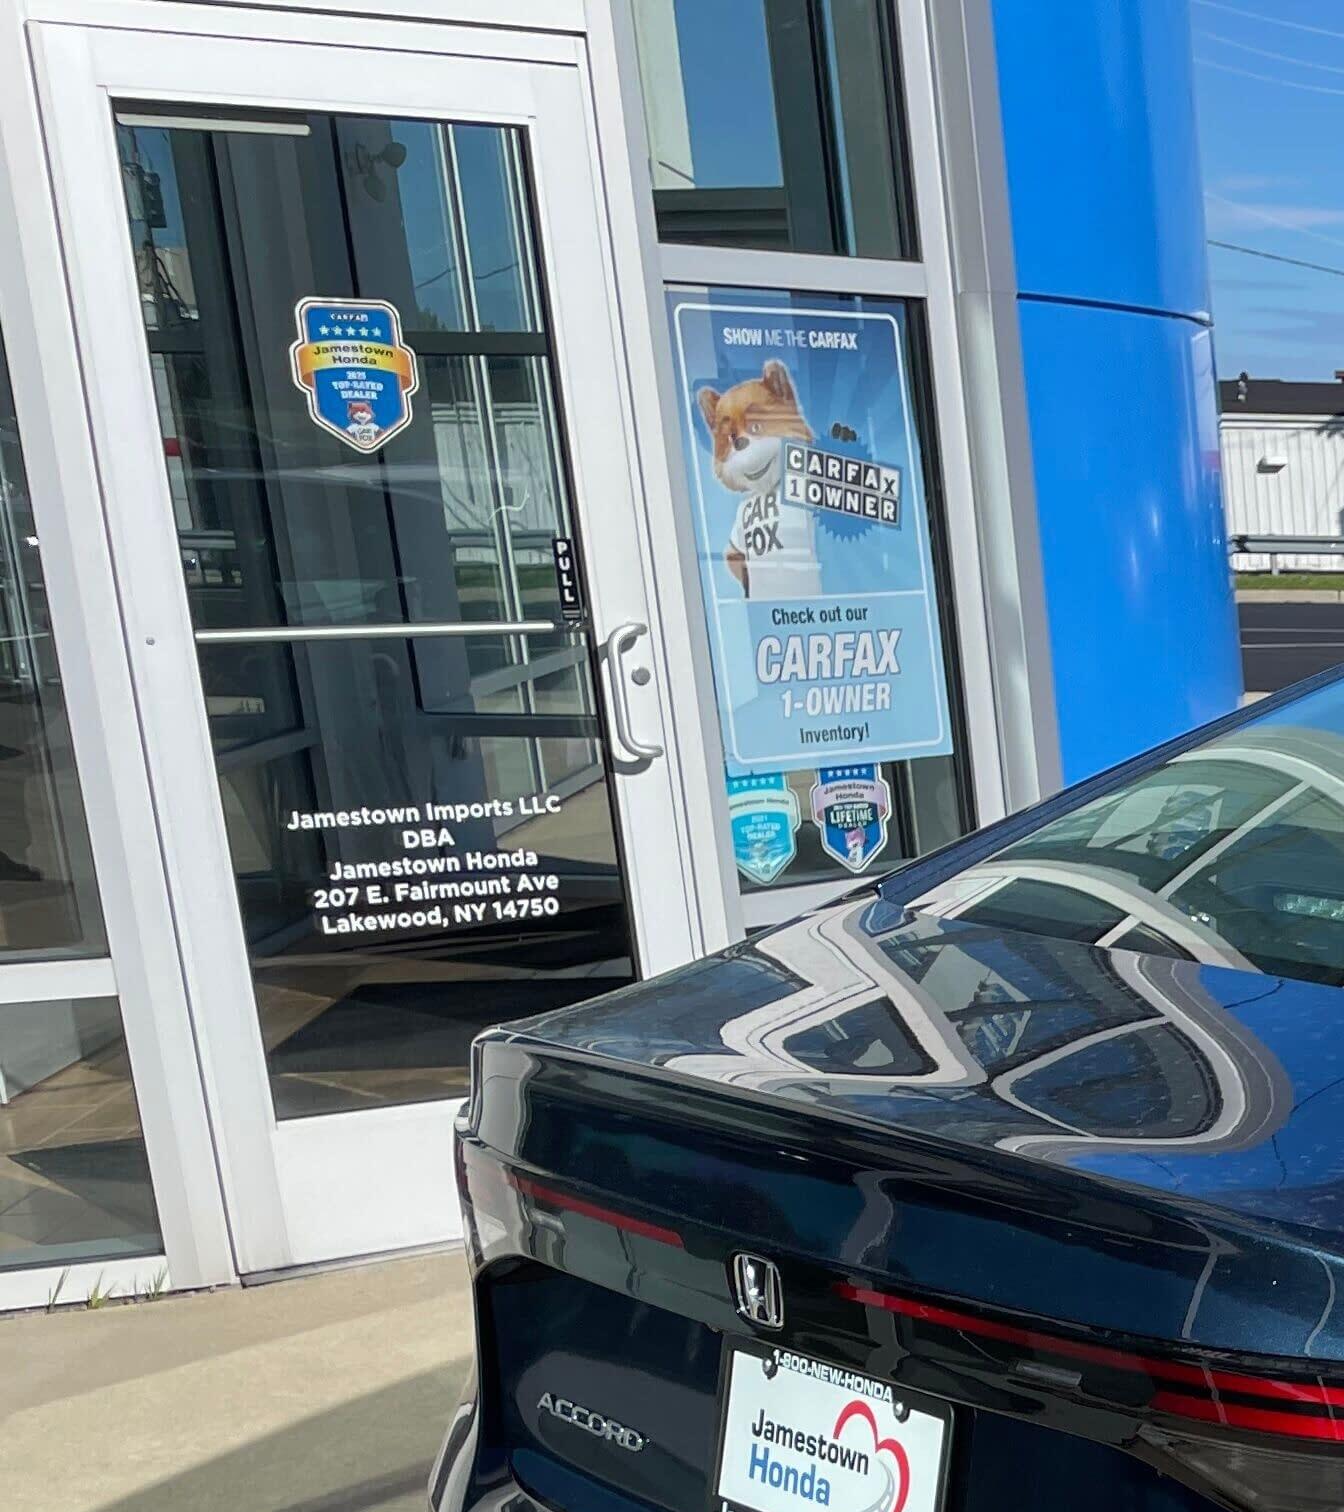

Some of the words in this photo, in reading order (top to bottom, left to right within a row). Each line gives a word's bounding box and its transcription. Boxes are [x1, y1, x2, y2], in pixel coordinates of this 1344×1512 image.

[313, 344, 394, 358] Jamestown
[723, 327, 762, 346] SHOW
[765, 330, 784, 347] ME
[786, 330, 808, 348] THE
[808, 331, 858, 350] CARFAX
[332, 355, 377, 365] Honda
[788, 448, 896, 496] CARFAX
[742, 491, 780, 530] CAR
[745, 519, 784, 556] FOX
[556, 541, 575, 602] PULL
[772, 607, 815, 625] Check
[819, 608, 842, 624] out
[845, 606, 868, 622] our
[755, 629, 903, 684] CARFAX
[782, 682, 891, 718] 1-OWNER
[799, 722, 871, 744] Inventory!
[287, 804, 420, 830] Jamestown
[426, 799, 513, 823] Imports
[519, 795, 562, 815] LLC
[830, 807, 874, 824] LIFETIME
[402, 829, 455, 849] DBA
[329, 854, 460, 881] Jamestown
[466, 848, 538, 870] Honda
[314, 887, 359, 908] 207
[367, 884, 389, 905] E.
[395, 876, 511, 902] Fairmount
[516, 873, 559, 892] Ave
[322, 905, 449, 934] Lakewood,
[454, 902, 486, 923] NY
[492, 897, 560, 920] 14750
[772, 1349, 894, 1403] 1-800-NEW-HONDA
[537, 1392, 645, 1453] ACCORD
[751, 1408, 870, 1476] Jamestown
[748, 1443, 831, 1506] Honda
